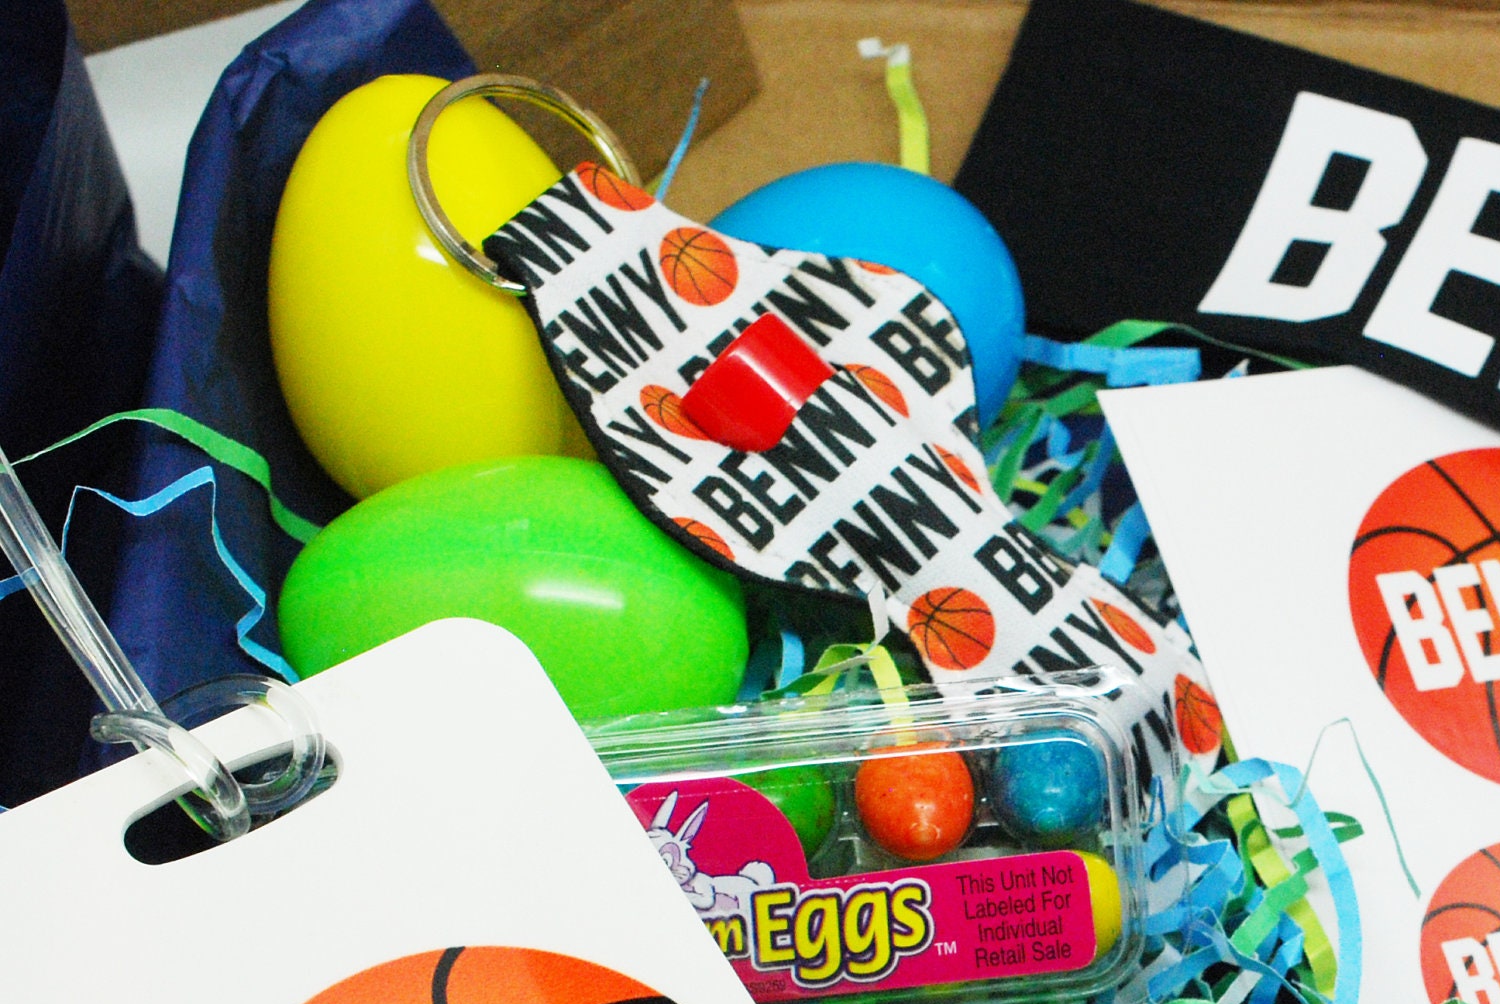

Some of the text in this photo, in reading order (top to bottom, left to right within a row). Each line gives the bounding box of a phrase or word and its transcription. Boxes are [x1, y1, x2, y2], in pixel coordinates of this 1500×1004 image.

[495, 172, 614, 290] NNY
[545, 248, 687, 394] ENNY
[692, 363, 897, 552] BENNY
[956, 866, 1074, 897] This Unit Not
[964, 891, 1071, 920] Labeled For
[752, 880, 932, 989] Eggs
[975, 941, 1072, 969] Retail Sale
[978, 916, 1064, 944] Individual
